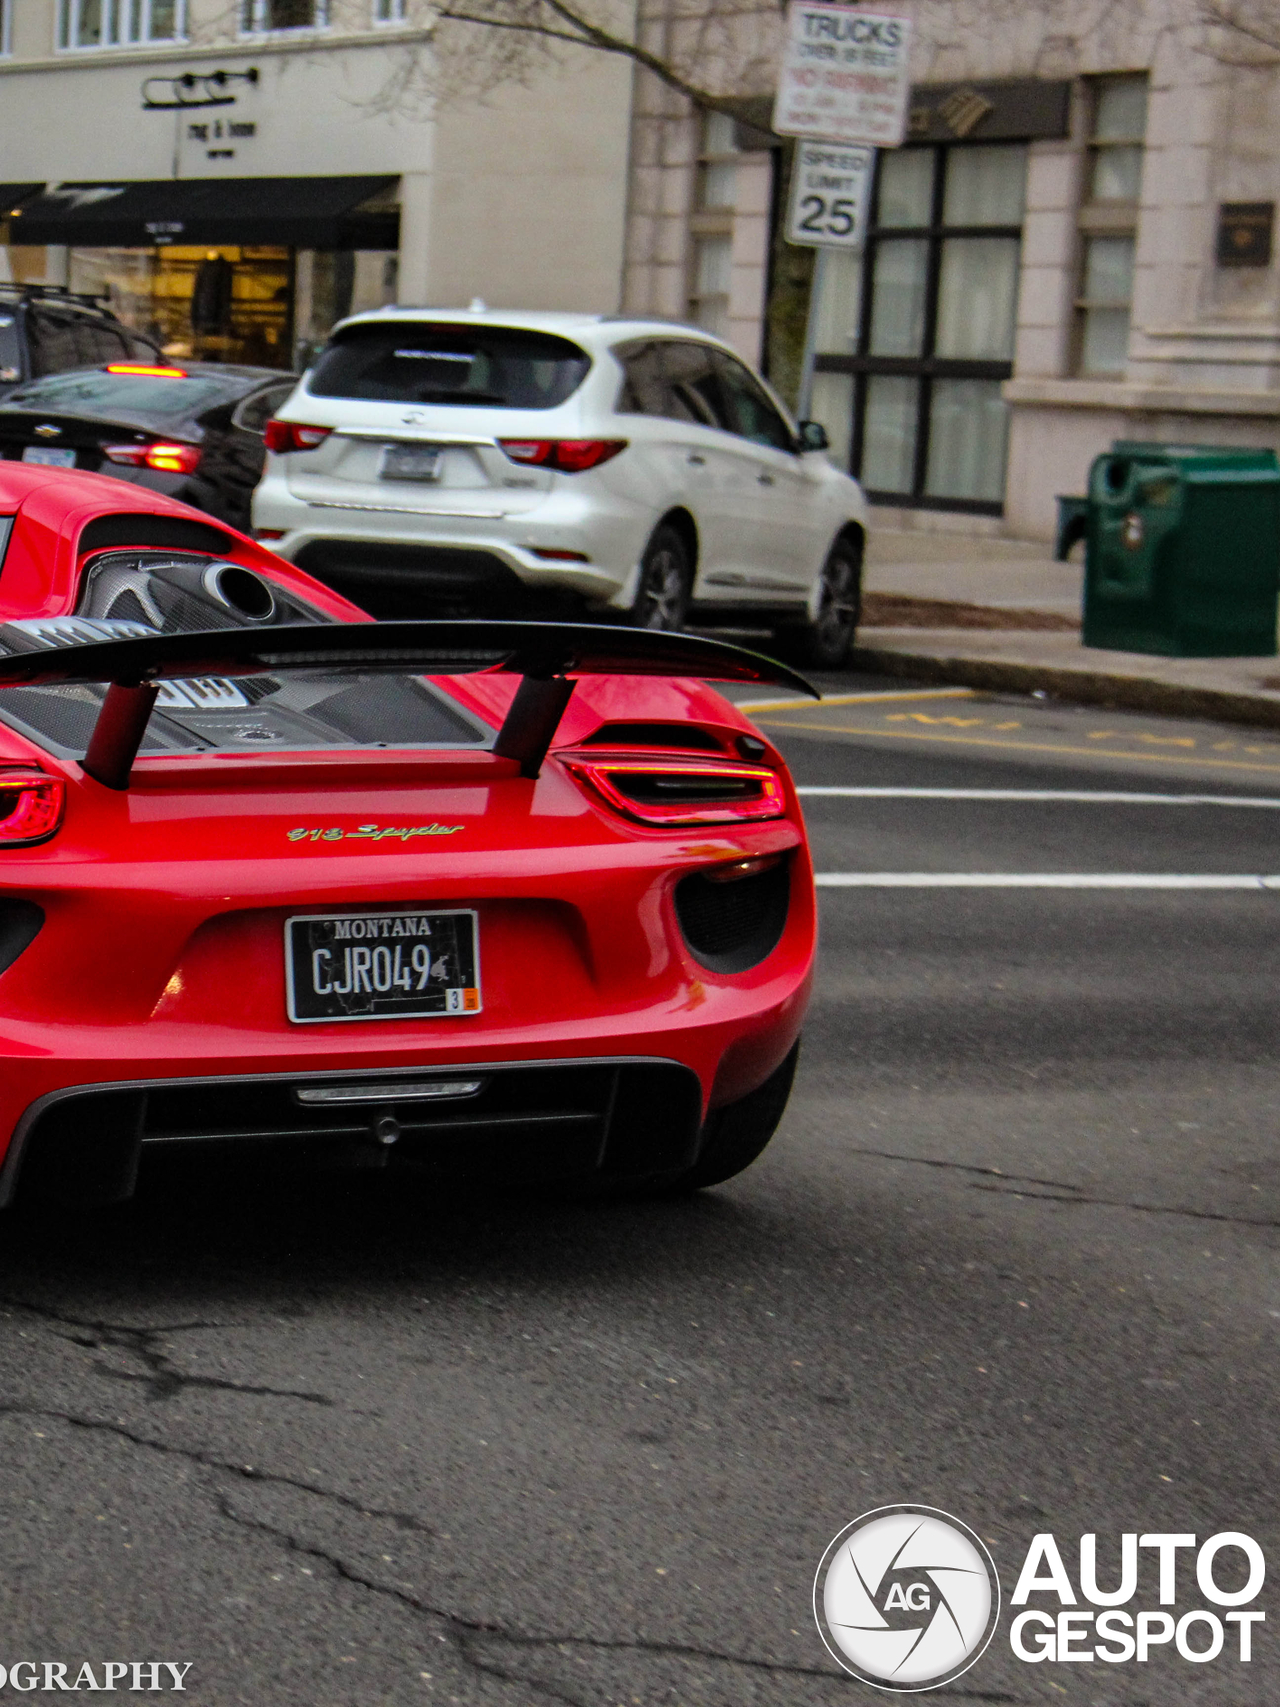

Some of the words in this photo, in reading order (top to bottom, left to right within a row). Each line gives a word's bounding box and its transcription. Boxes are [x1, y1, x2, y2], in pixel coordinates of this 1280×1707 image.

[802, 13, 901, 47] TRUCKS
[803, 151, 863, 171] SPEED
[806, 173, 854, 191] LIMIT
[799, 194, 855, 237] 25
[286, 828, 344, 841] 918
[345, 823, 465, 841] Spyder
[334, 917, 432, 940] MONTANA
[312, 944, 430, 994] CJR049
[452, 991, 459, 1009] 3
